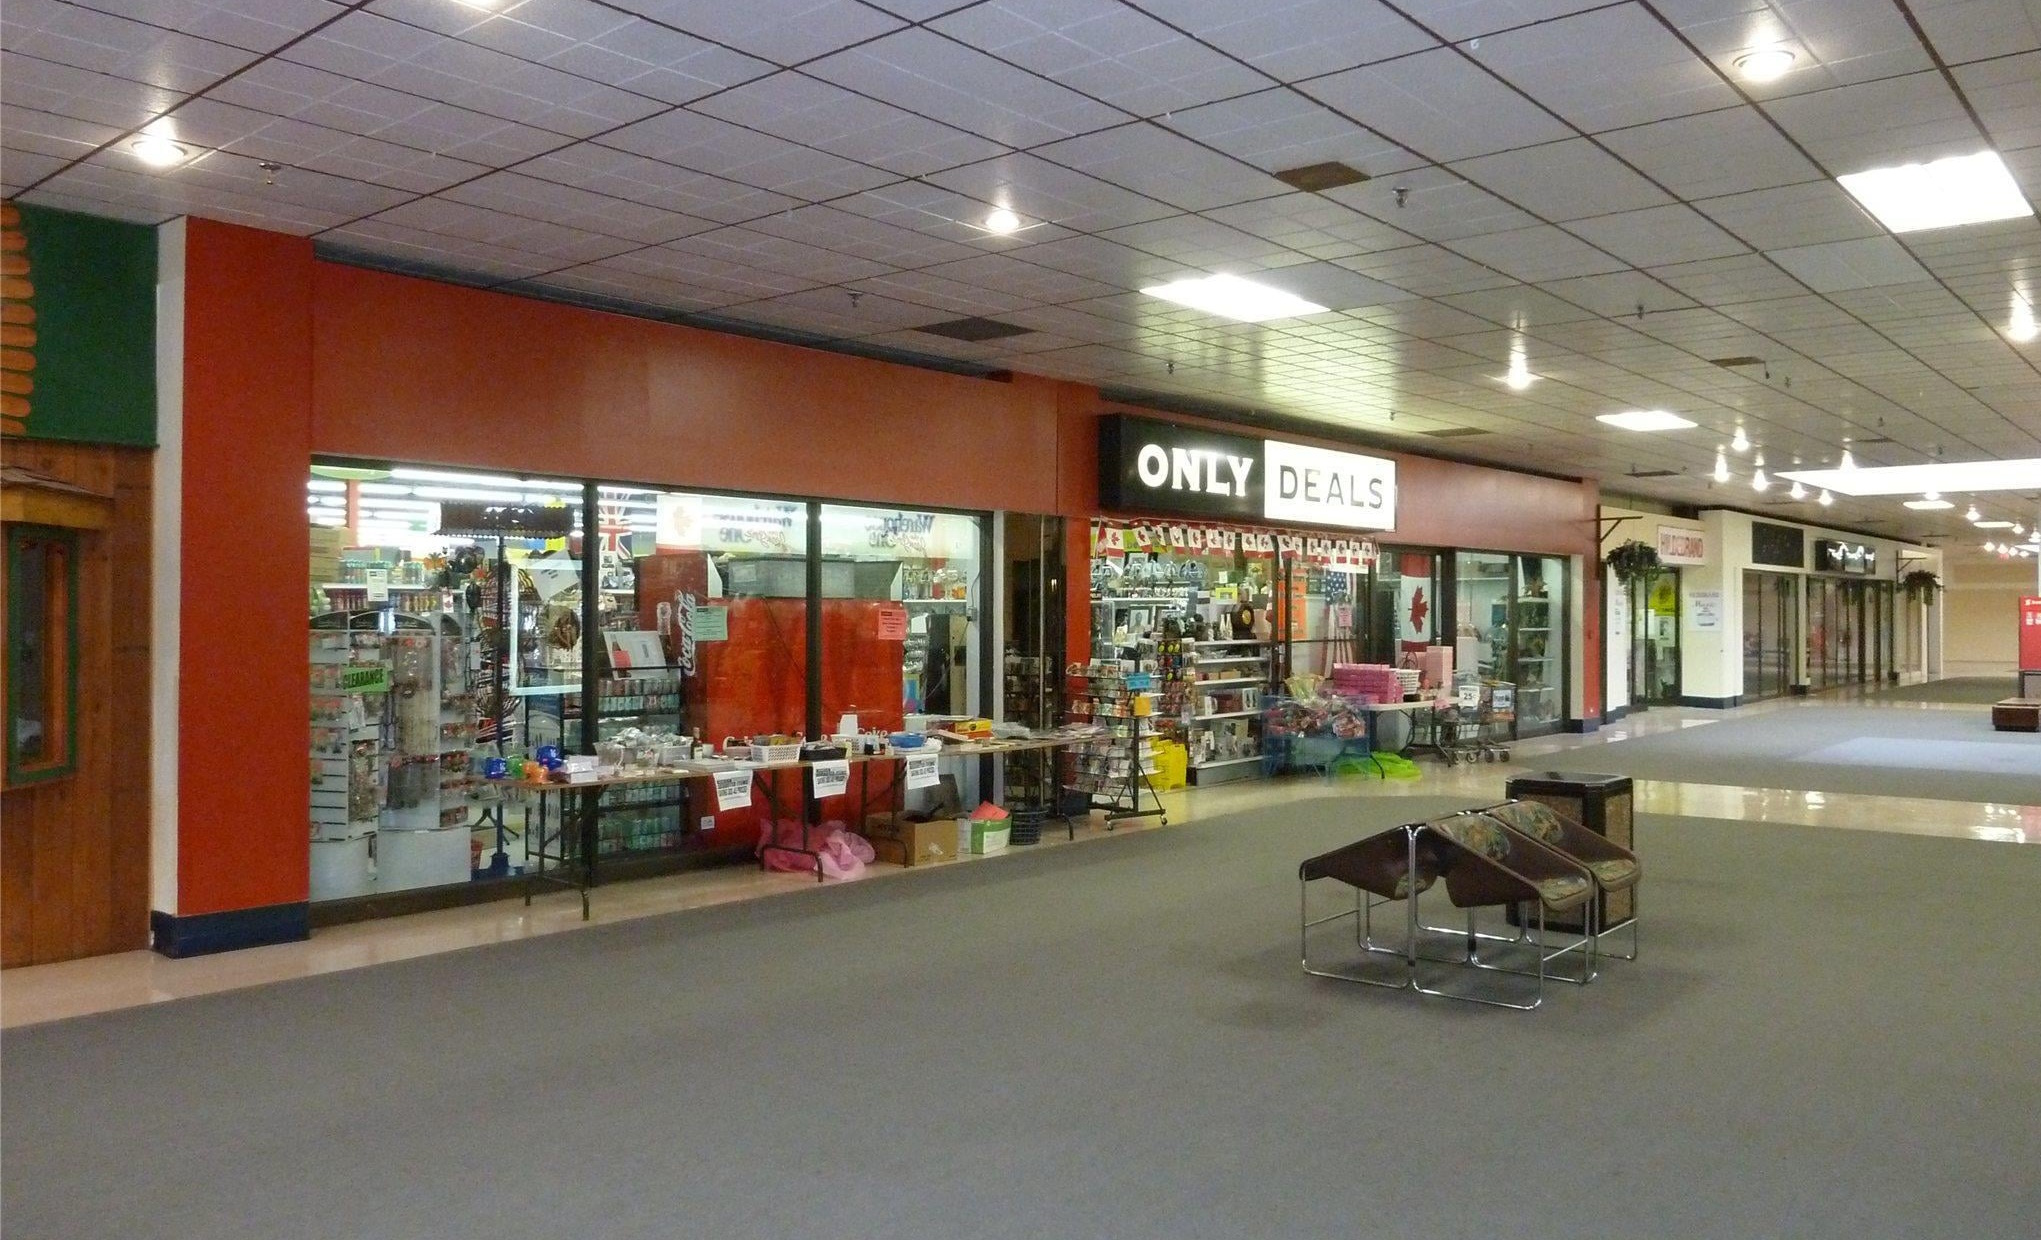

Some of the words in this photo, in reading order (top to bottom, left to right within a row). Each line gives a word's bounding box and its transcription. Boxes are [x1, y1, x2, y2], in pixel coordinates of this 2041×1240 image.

[1138, 444, 1253, 497] ONLY
[1280, 465, 1382, 509] DEALS
[343, 669, 383, 689] CLEARANCE
